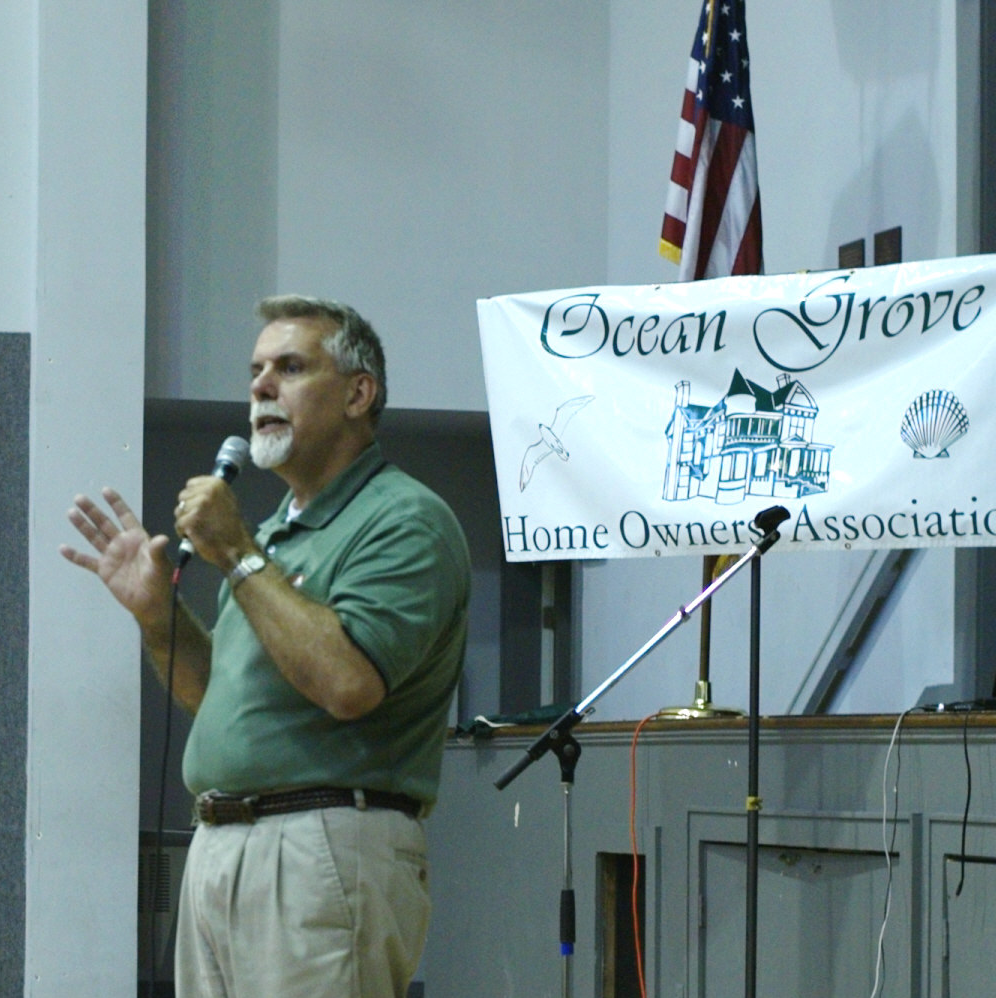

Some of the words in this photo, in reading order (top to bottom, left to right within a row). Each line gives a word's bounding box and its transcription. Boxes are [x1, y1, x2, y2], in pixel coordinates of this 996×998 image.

[539, 292, 728, 359] Ocean
[752, 275, 986, 373] Grove
[503, 515, 609, 553] Home
